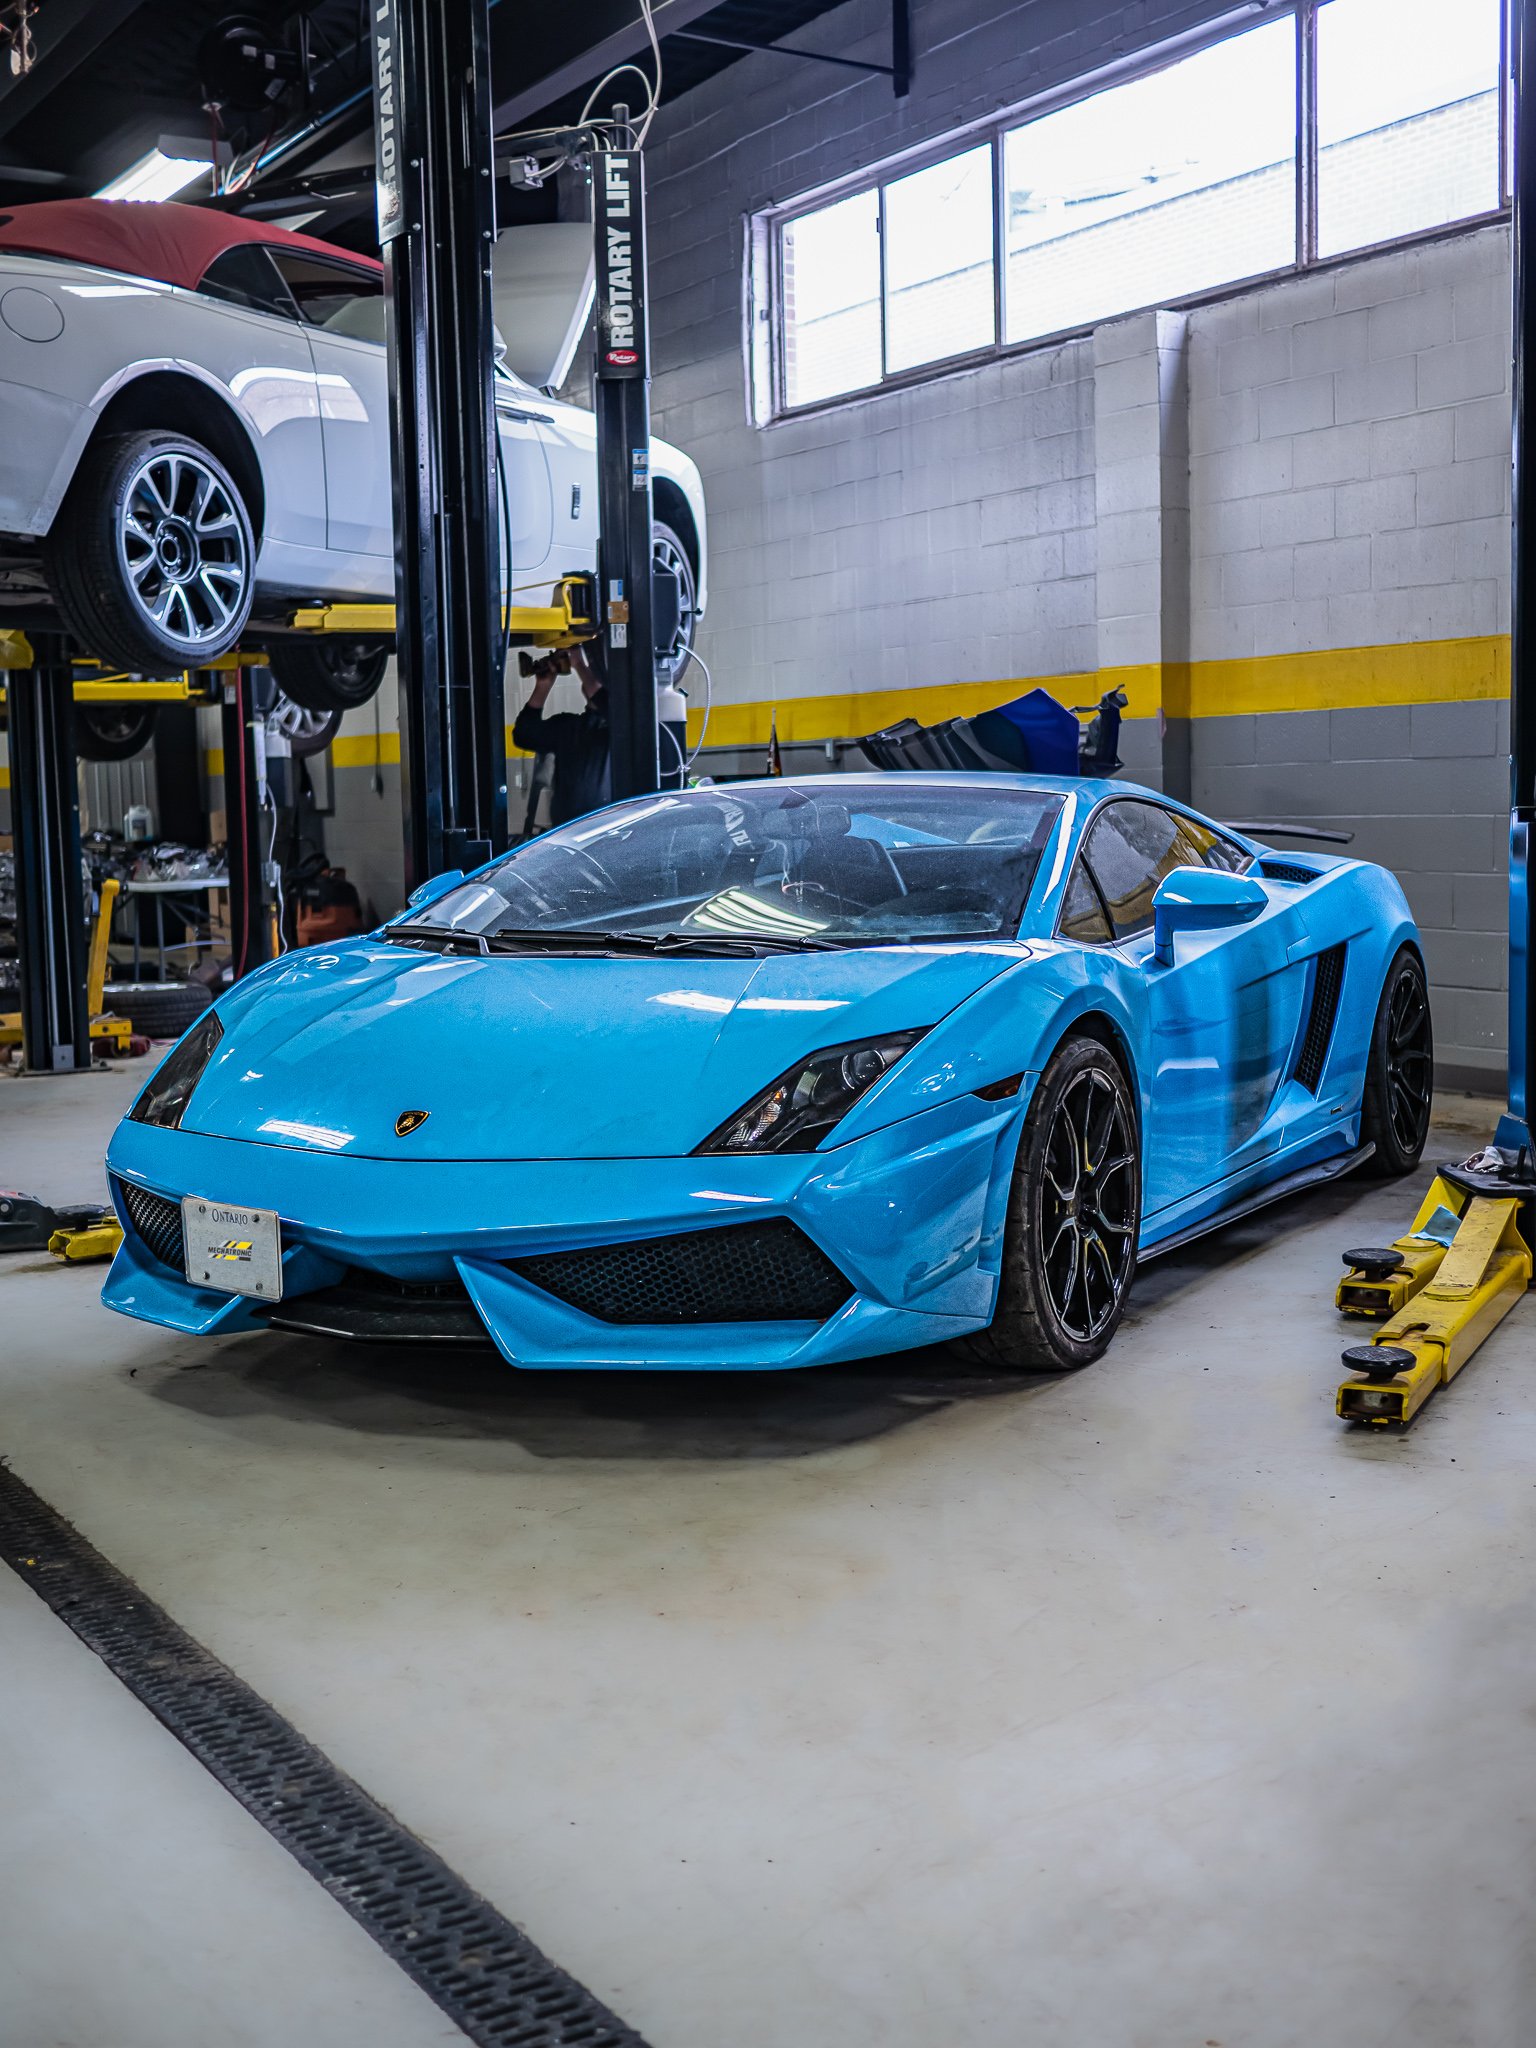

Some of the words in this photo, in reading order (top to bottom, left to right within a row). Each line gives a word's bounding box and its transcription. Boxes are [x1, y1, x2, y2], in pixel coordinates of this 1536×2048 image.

[604, 153, 631, 218] LIFT
[606, 225, 634, 348] ROTARY
[207, 1246, 252, 1257] MECHATRONIC
